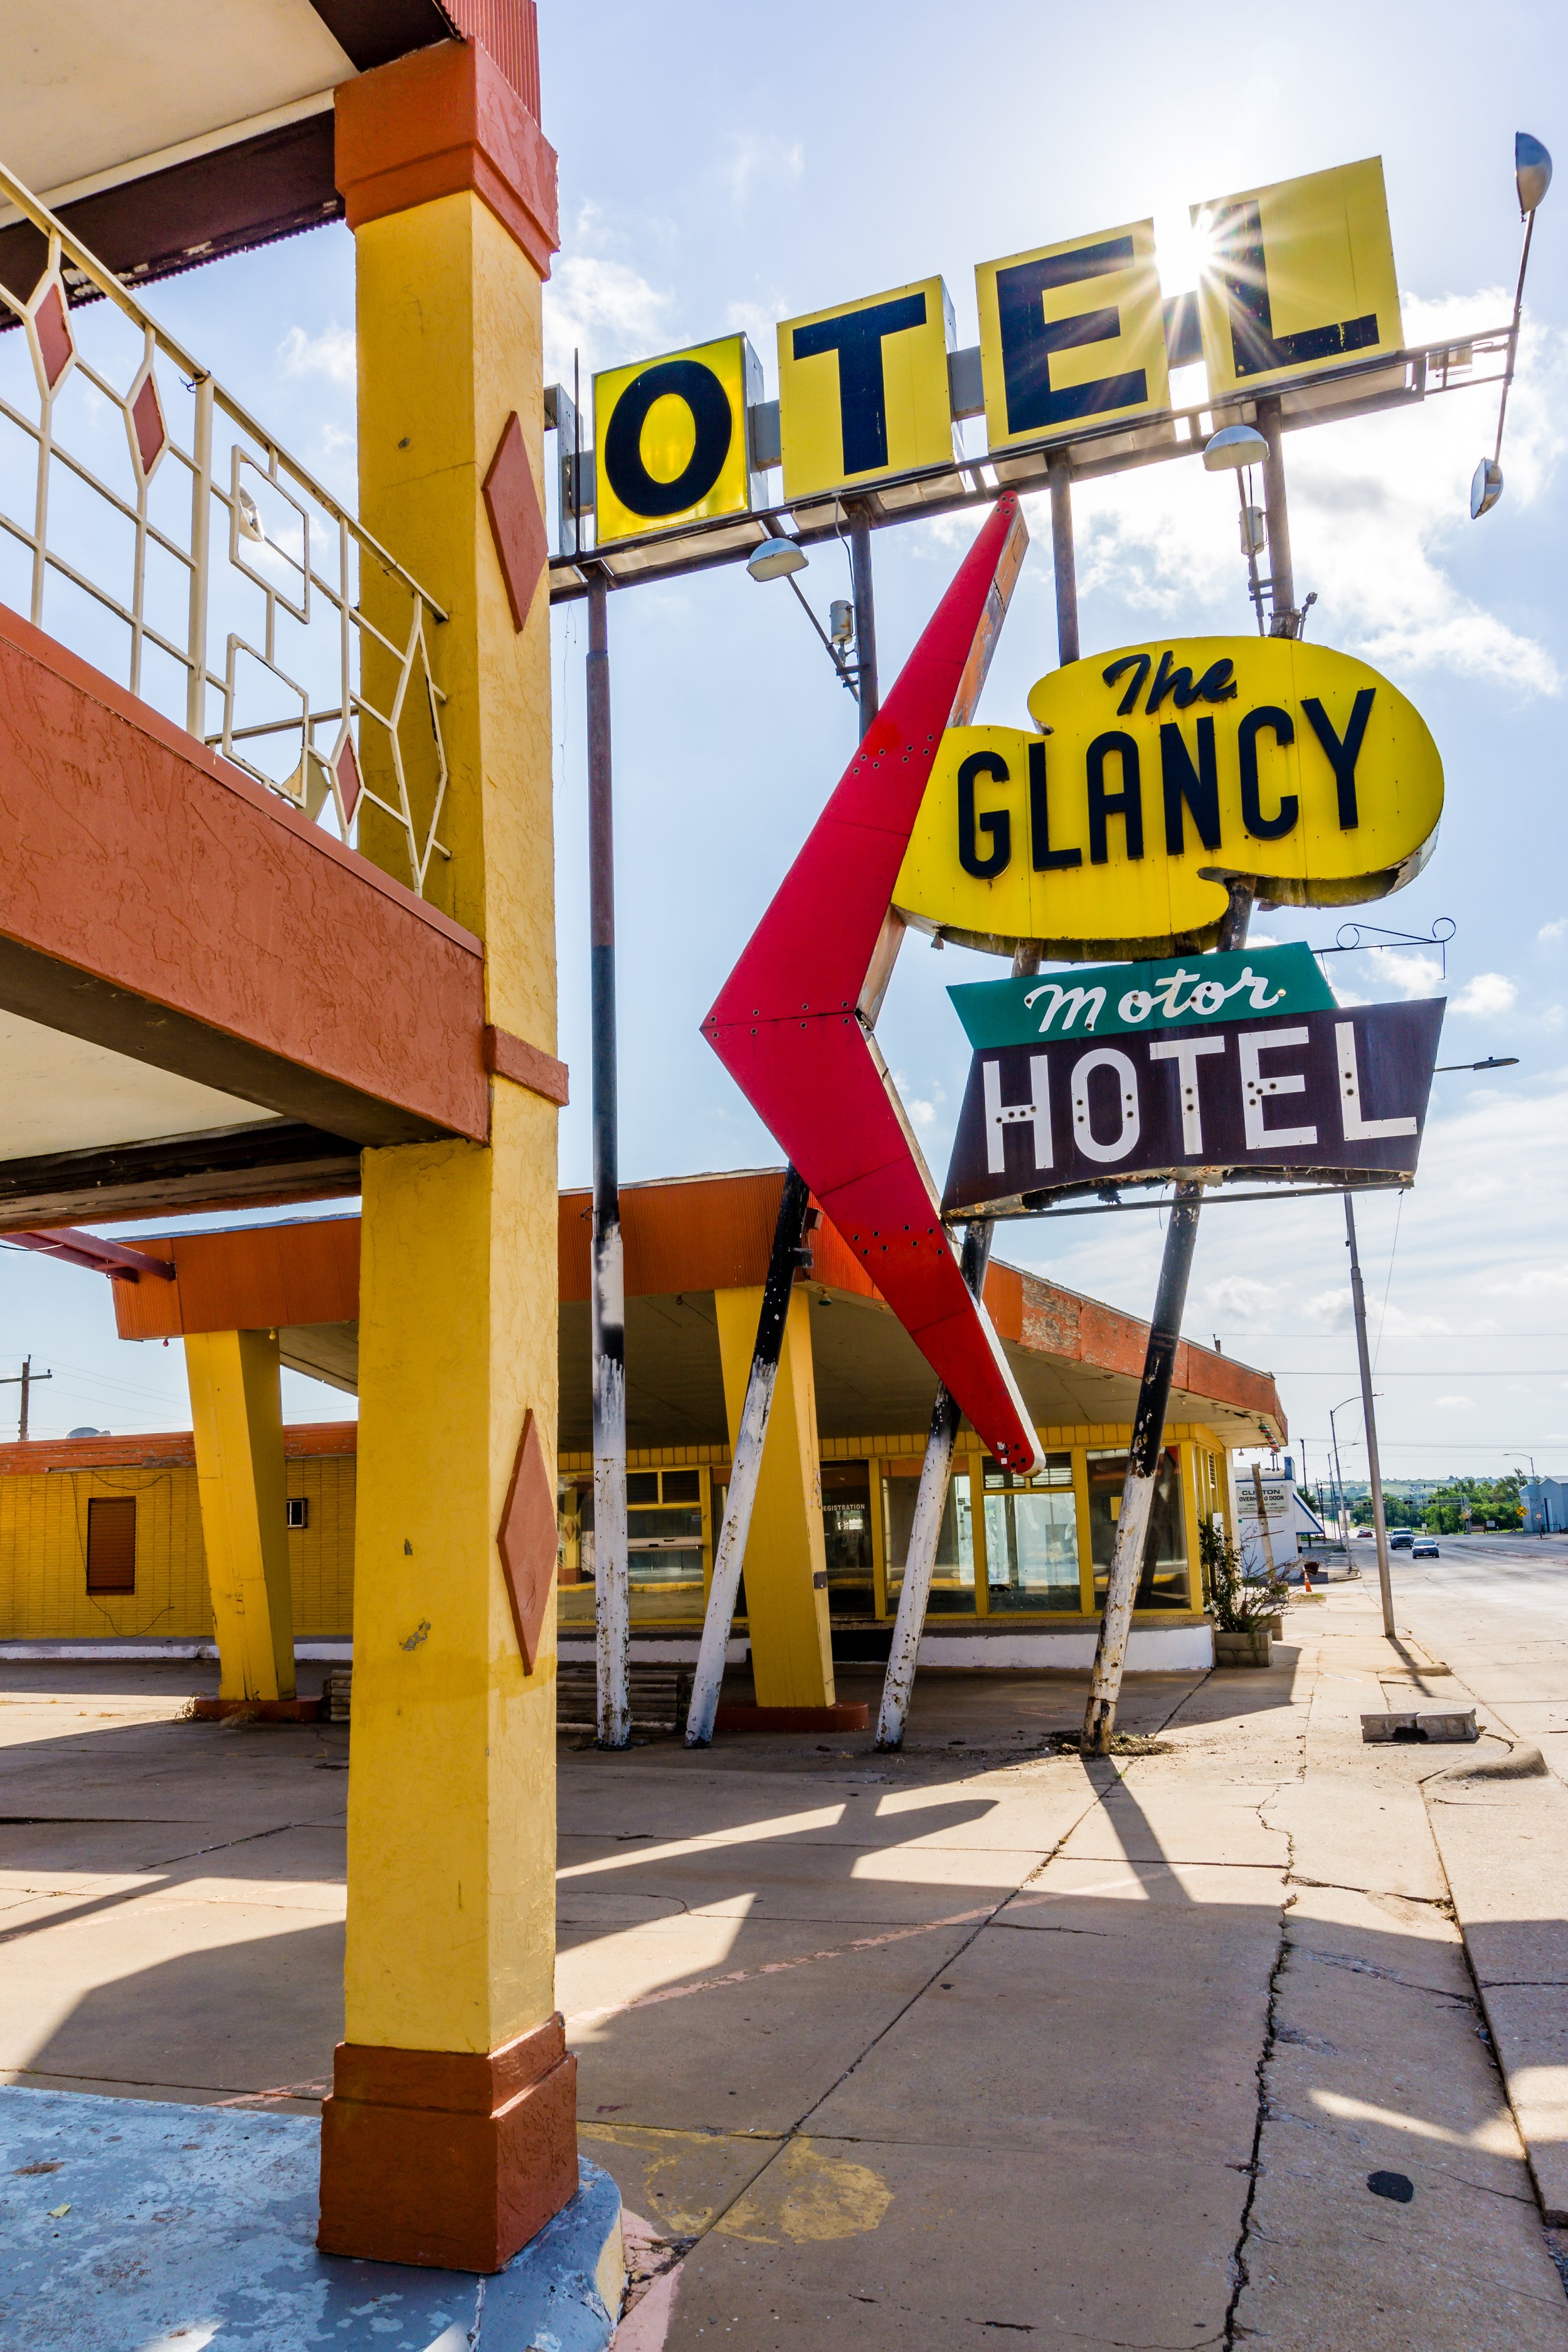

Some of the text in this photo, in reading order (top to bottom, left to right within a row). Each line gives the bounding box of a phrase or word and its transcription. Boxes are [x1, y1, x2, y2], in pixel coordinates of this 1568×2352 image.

[605, 199, 1380, 517] OTEL
[1102, 650, 1237, 716] The
[957, 687, 1377, 879] GLANCY
[1024, 967, 1279, 1033] Motor
[982, 1021, 1418, 1174] HOTEL
